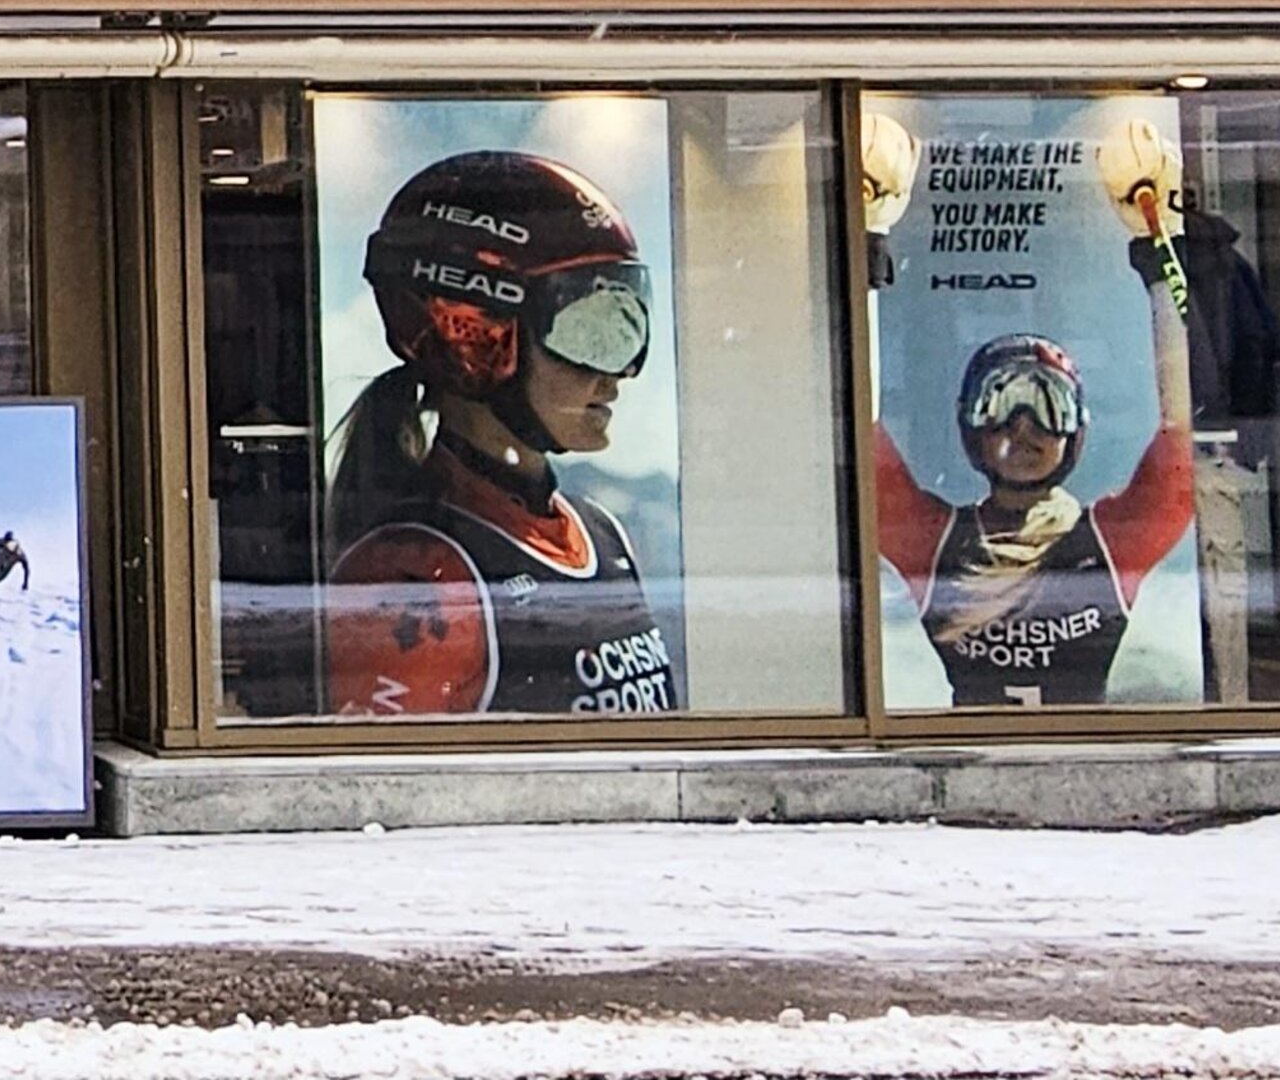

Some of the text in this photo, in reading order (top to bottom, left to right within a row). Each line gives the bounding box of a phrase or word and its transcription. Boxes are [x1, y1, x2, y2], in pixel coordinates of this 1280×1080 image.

[929, 142, 1083, 165] WE MAKE THE
[422, 201, 530, 244] HEAD
[931, 203, 1047, 225] YOU MAKE
[930, 229, 1030, 253] HISTORY.
[412, 258, 526, 304] HEAD
[931, 274, 1037, 290] HEAD
[955, 638, 1055, 669] SPORT
